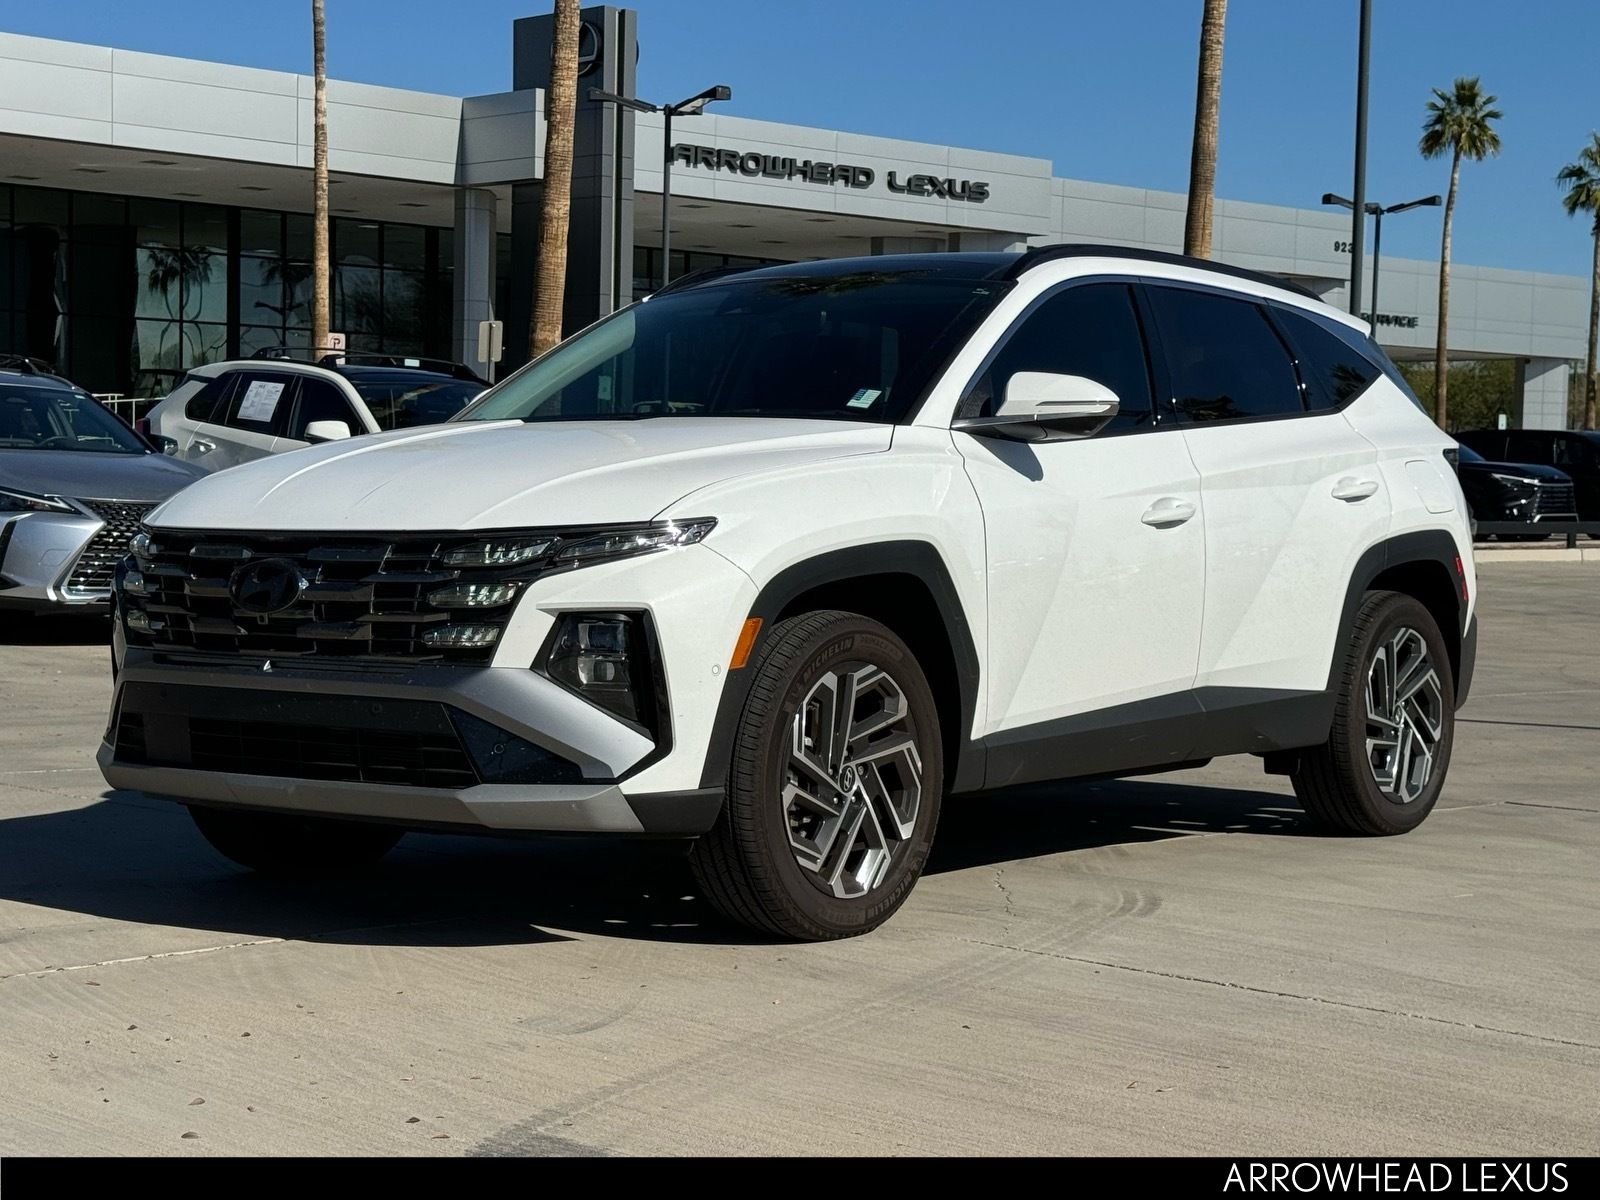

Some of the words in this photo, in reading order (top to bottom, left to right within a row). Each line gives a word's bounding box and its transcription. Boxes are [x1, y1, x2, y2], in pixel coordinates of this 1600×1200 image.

[671, 143, 875, 189] ARROWHEAD
[887, 171, 990, 203] LEXUS
[1361, 312, 1419, 328] SRVICE
[803, 638, 854, 683] MICHELIN
